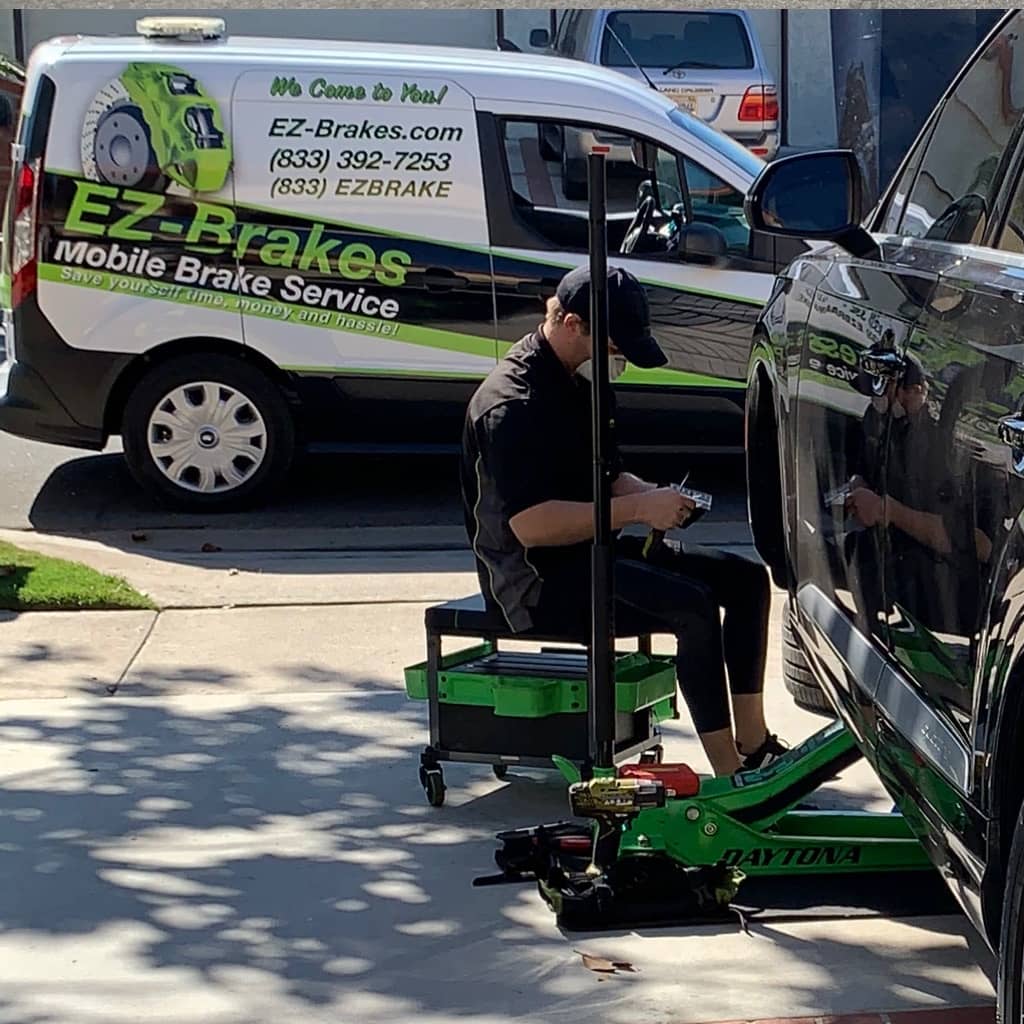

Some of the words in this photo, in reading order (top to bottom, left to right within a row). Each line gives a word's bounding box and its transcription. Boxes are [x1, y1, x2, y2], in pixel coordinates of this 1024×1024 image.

[270, 76, 302, 97] We
[309, 78, 367, 101] Come
[372, 82, 394, 102] to
[400, 82, 448, 105] You!
[269, 118, 463, 142] EZ-Brakes.com
[270, 148, 330, 174] (833)
[336, 150, 451, 172] 392-7253
[270, 177, 327, 199] (833)
[335, 178, 453, 198] EZBRAKE
[64, 179, 412, 287] EZ-Brakes
[53, 240, 166, 278] Mobile
[174, 255, 272, 297] Brake
[280, 275, 400, 319] Service
[60, 266, 104, 286] Save
[110, 276, 182, 299] yourself
[235, 297, 292, 320] money
[299, 308, 331, 325] and
[336, 313, 400, 337] hassle!
[720, 846, 862, 867] DAYTONA
